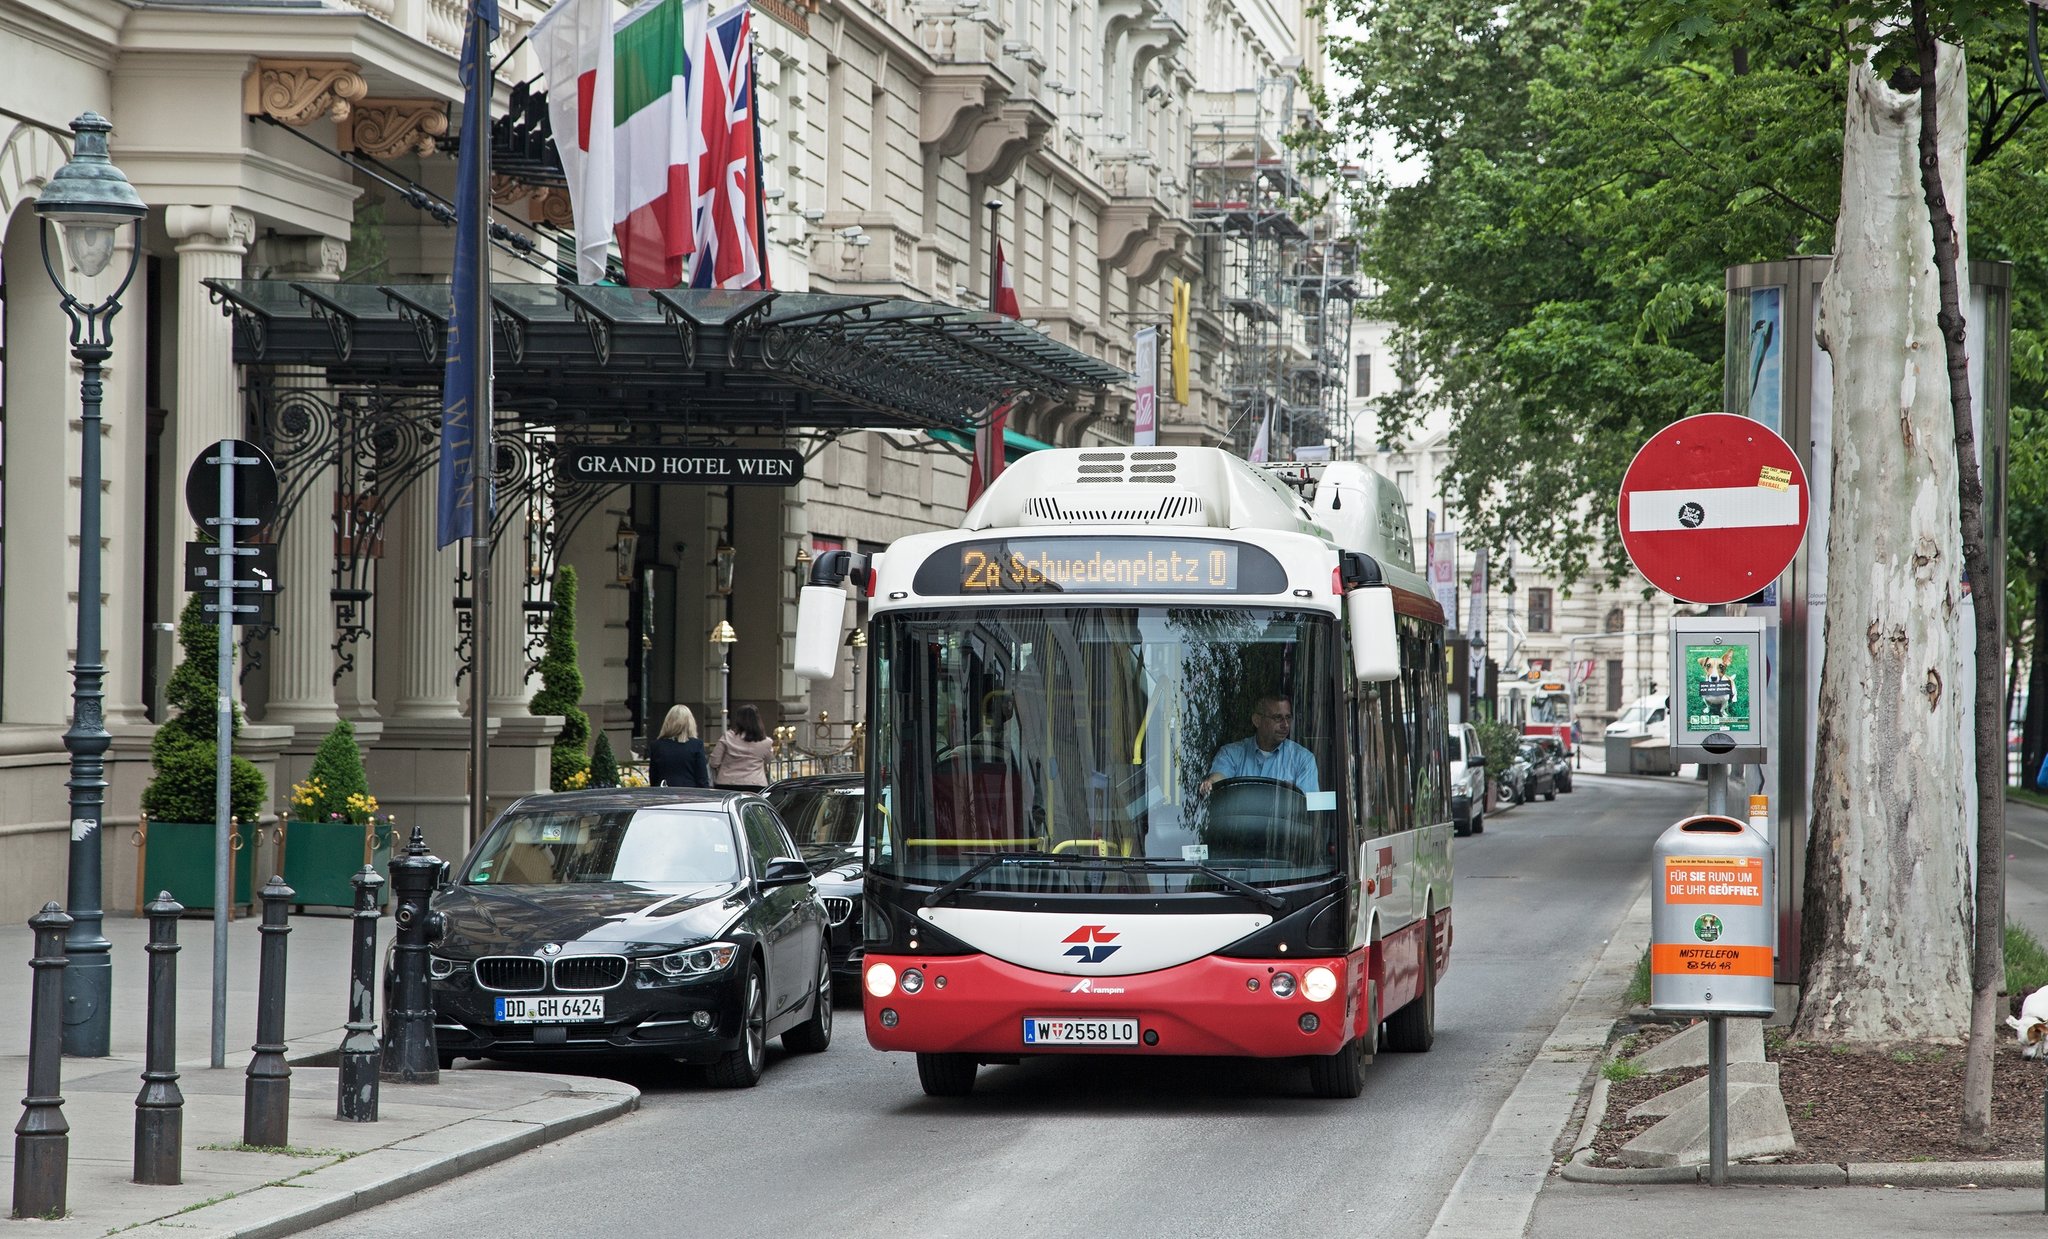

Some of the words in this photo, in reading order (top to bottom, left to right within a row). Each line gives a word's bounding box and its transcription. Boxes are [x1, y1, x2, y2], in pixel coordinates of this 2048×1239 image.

[445, 396, 474, 509] WIEN
[577, 456, 656, 473] GRAND
[662, 457, 731, 475] HOTEL
[737, 459, 793, 476] WIEN
[963, 551, 1000, 588] 2A
[1010, 551, 1200, 585] Schwedenplatz
[1670, 870, 1687, 881] FÜR
[1690, 872, 1706, 881] SIE
[1708, 872, 1735, 882] RUND
[1738, 873, 1752, 882] UM
[1670, 885, 1684, 895] DIE
[1687, 885, 1706, 895] UHR
[1708, 883, 1759, 896] GEÖFFNET.
[1679, 949, 1740, 959] MISTTELEFON
[1700, 961, 1716, 970] 546
[1719, 962, 1732, 970] 48
[1093, 986, 1125, 995] rampini
[506, 1000, 525, 1017] DD
[538, 1000, 558, 1017] GH
[562, 999, 601, 1015] 6424
[1038, 1023, 1050, 1040] W
[1064, 1023, 1108, 1040] 2558
[1112, 1023, 1132, 1040] LO
